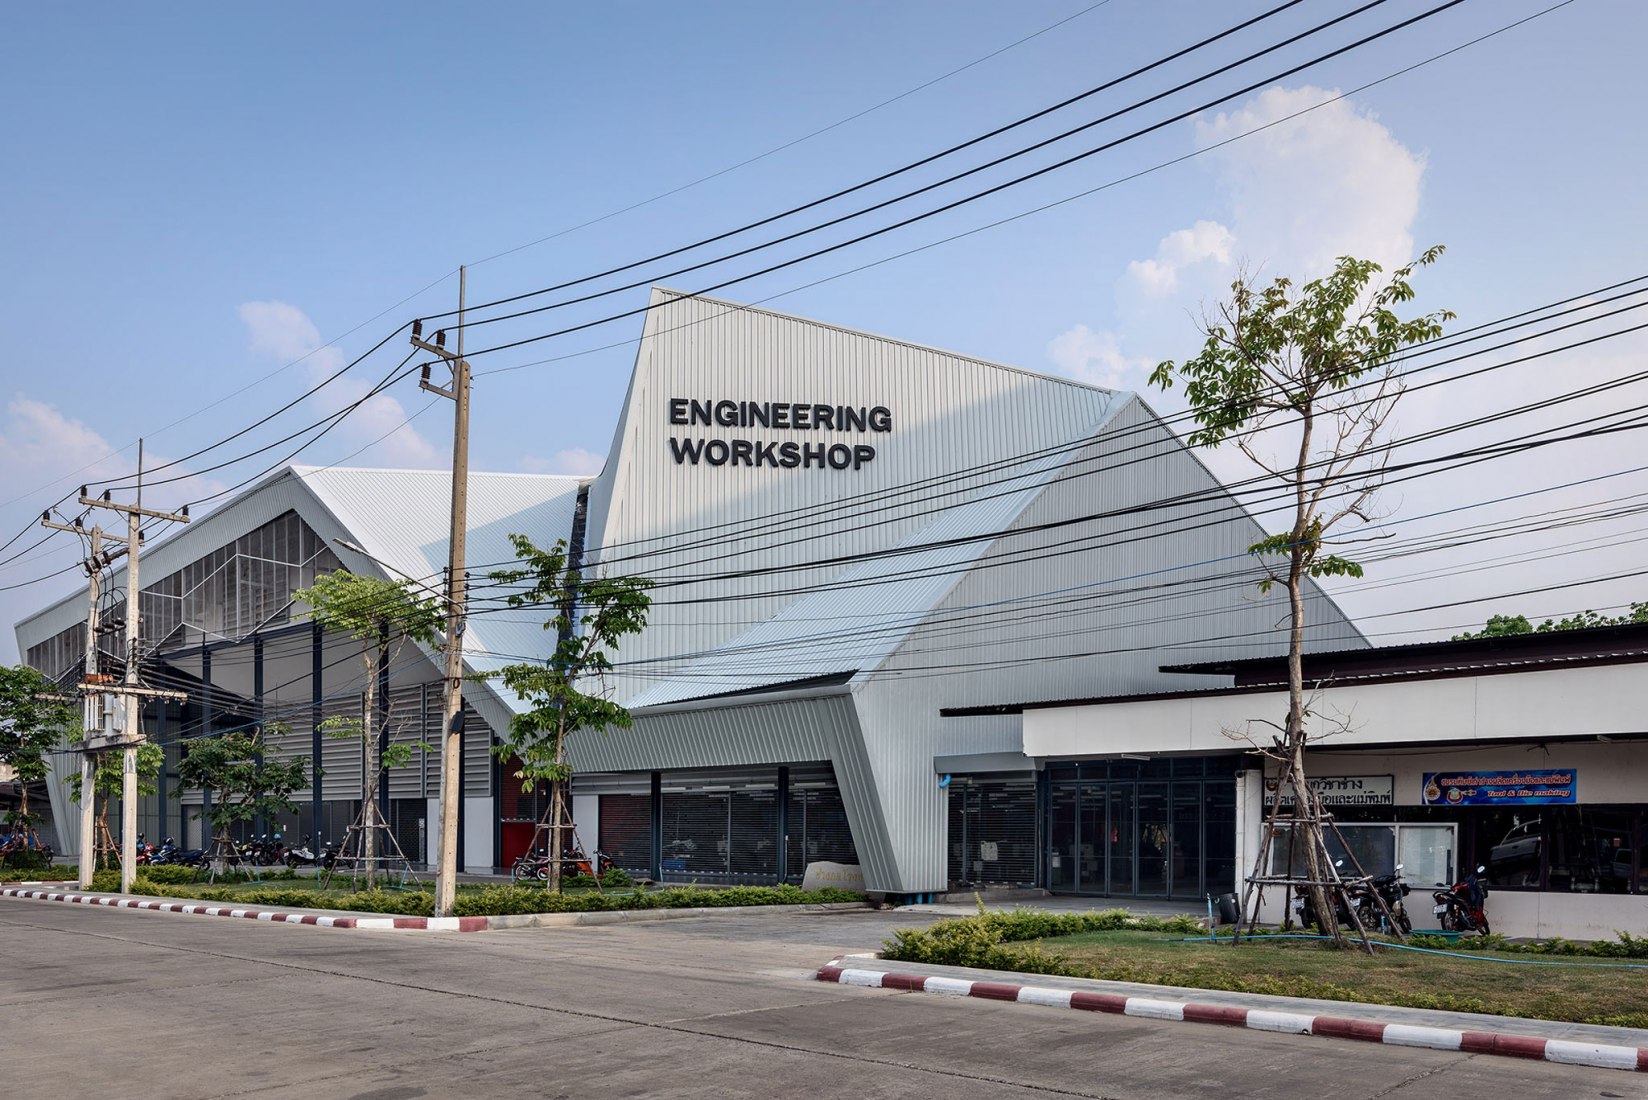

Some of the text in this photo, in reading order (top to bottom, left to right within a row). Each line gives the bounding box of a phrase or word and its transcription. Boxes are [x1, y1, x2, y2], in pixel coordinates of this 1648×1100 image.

[669, 397, 892, 432] ENGINEERING
[669, 437, 876, 470] WORKSHOP
[1534, 789, 1570, 797] making
